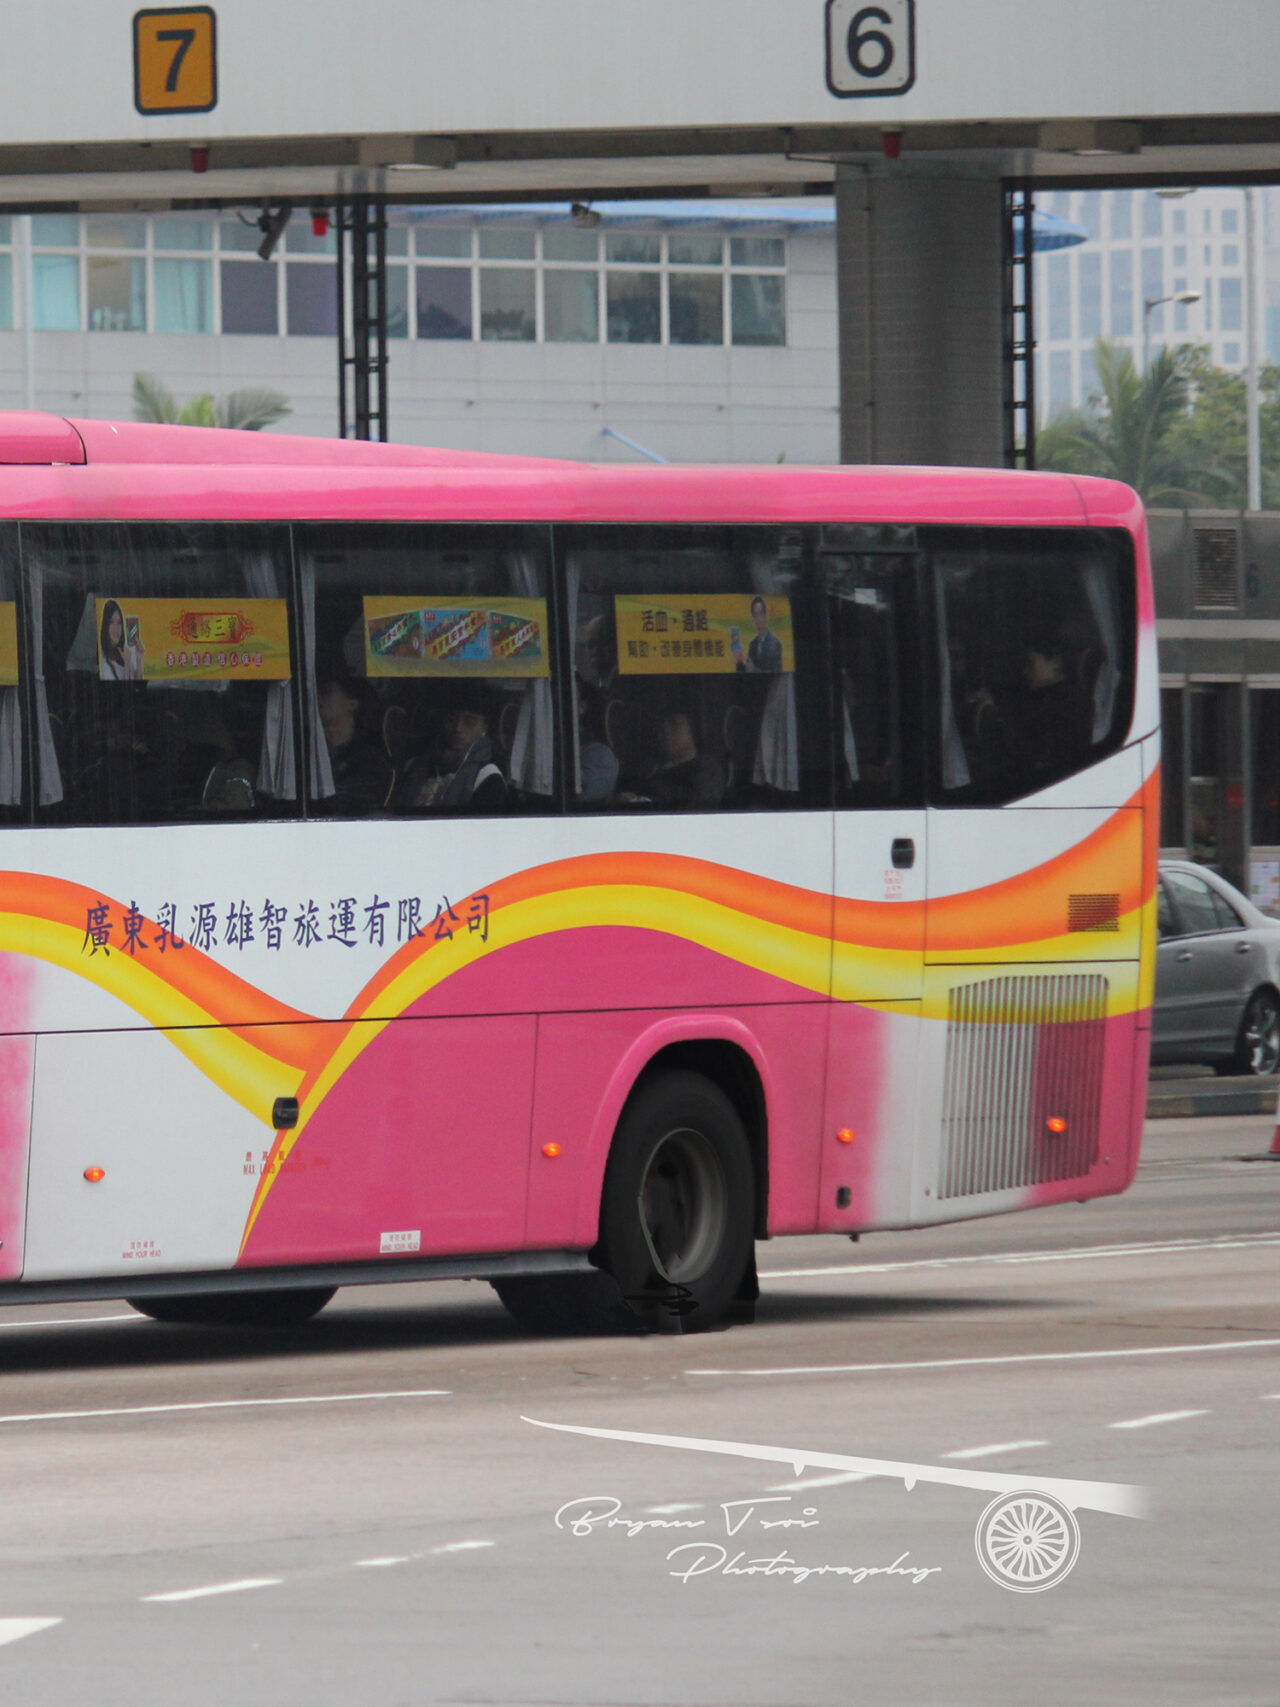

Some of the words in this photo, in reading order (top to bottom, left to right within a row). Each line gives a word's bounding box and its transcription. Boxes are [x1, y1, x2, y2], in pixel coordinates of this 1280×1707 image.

[156, 29, 196, 92] 7
[847, 7, 894, 78] 6
[81, 893, 491, 957] 廣東乳源雄智旅運有限公司
